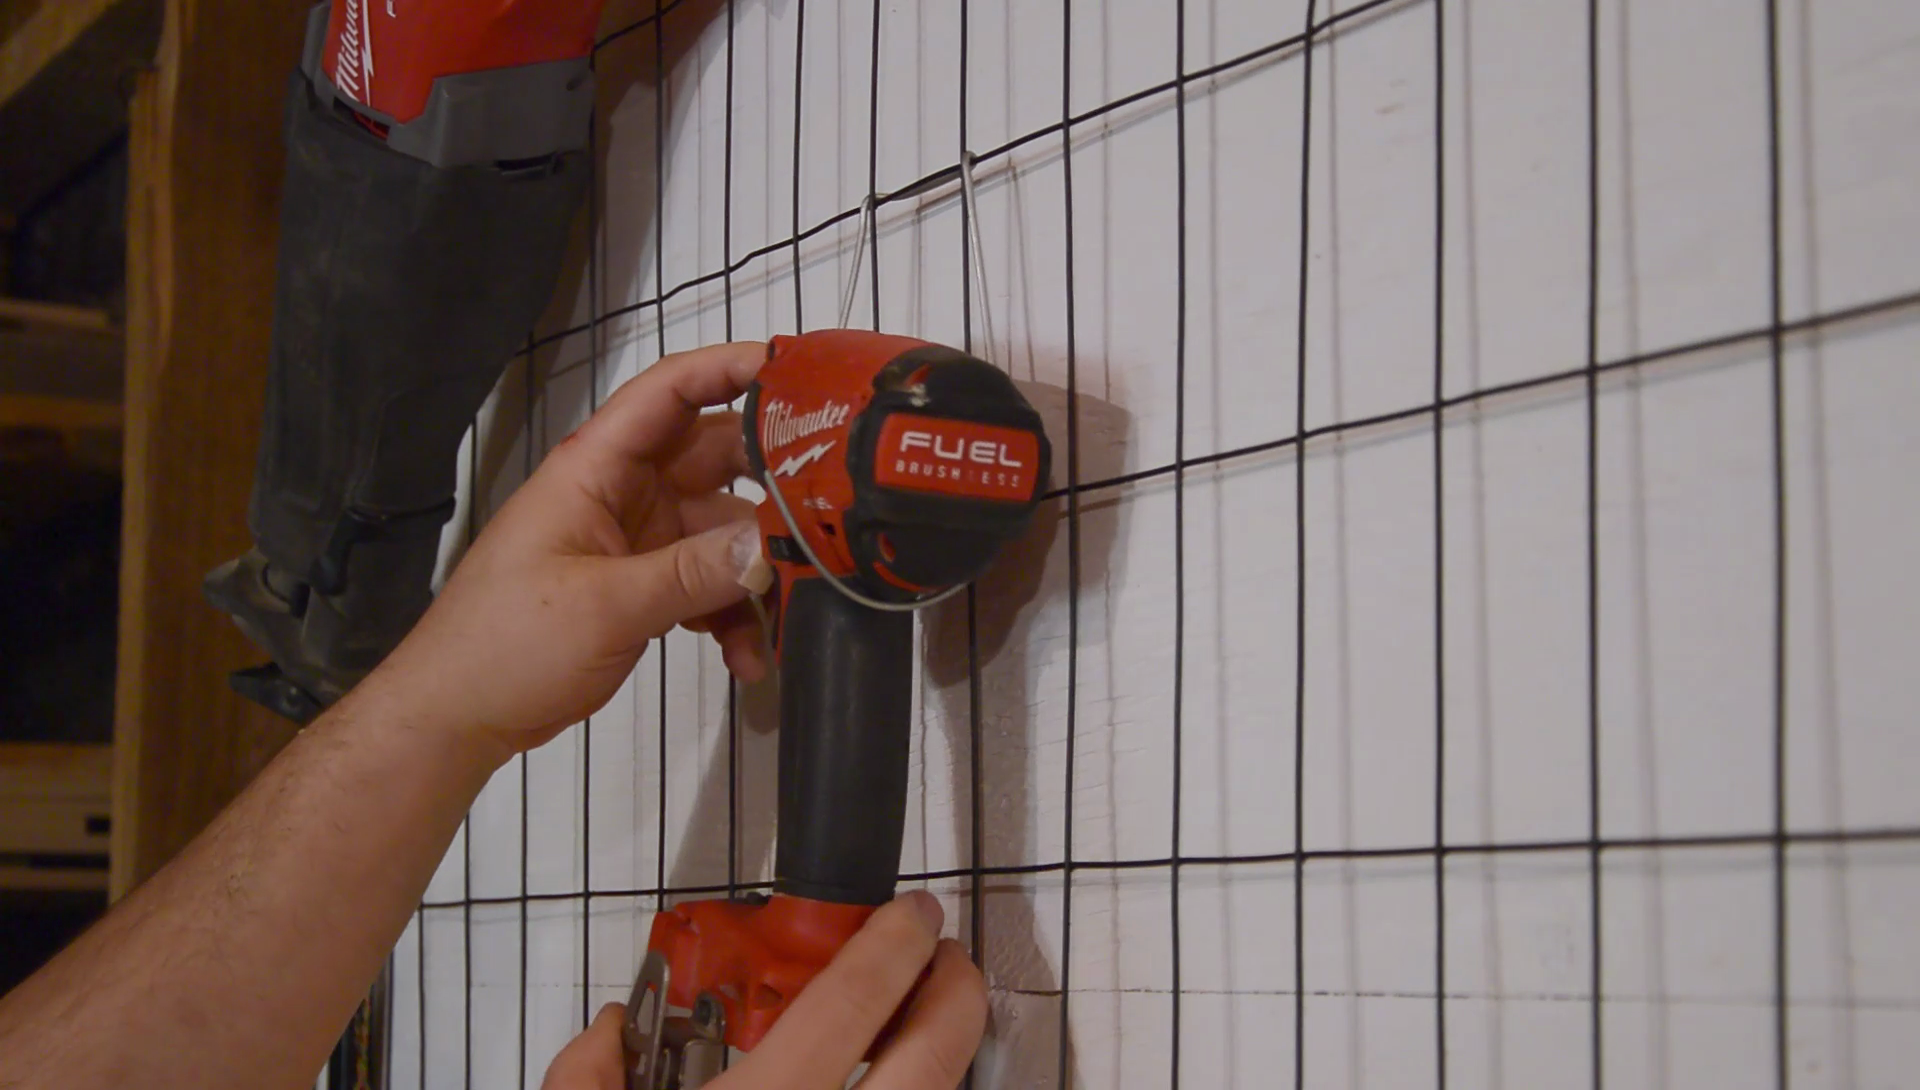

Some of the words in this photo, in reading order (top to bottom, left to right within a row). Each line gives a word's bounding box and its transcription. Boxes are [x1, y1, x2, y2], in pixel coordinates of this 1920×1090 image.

[763, 399, 850, 453] Milwaukee
[900, 431, 1022, 468] FUEL
[895, 460, 1019, 487] BRUSHESS
